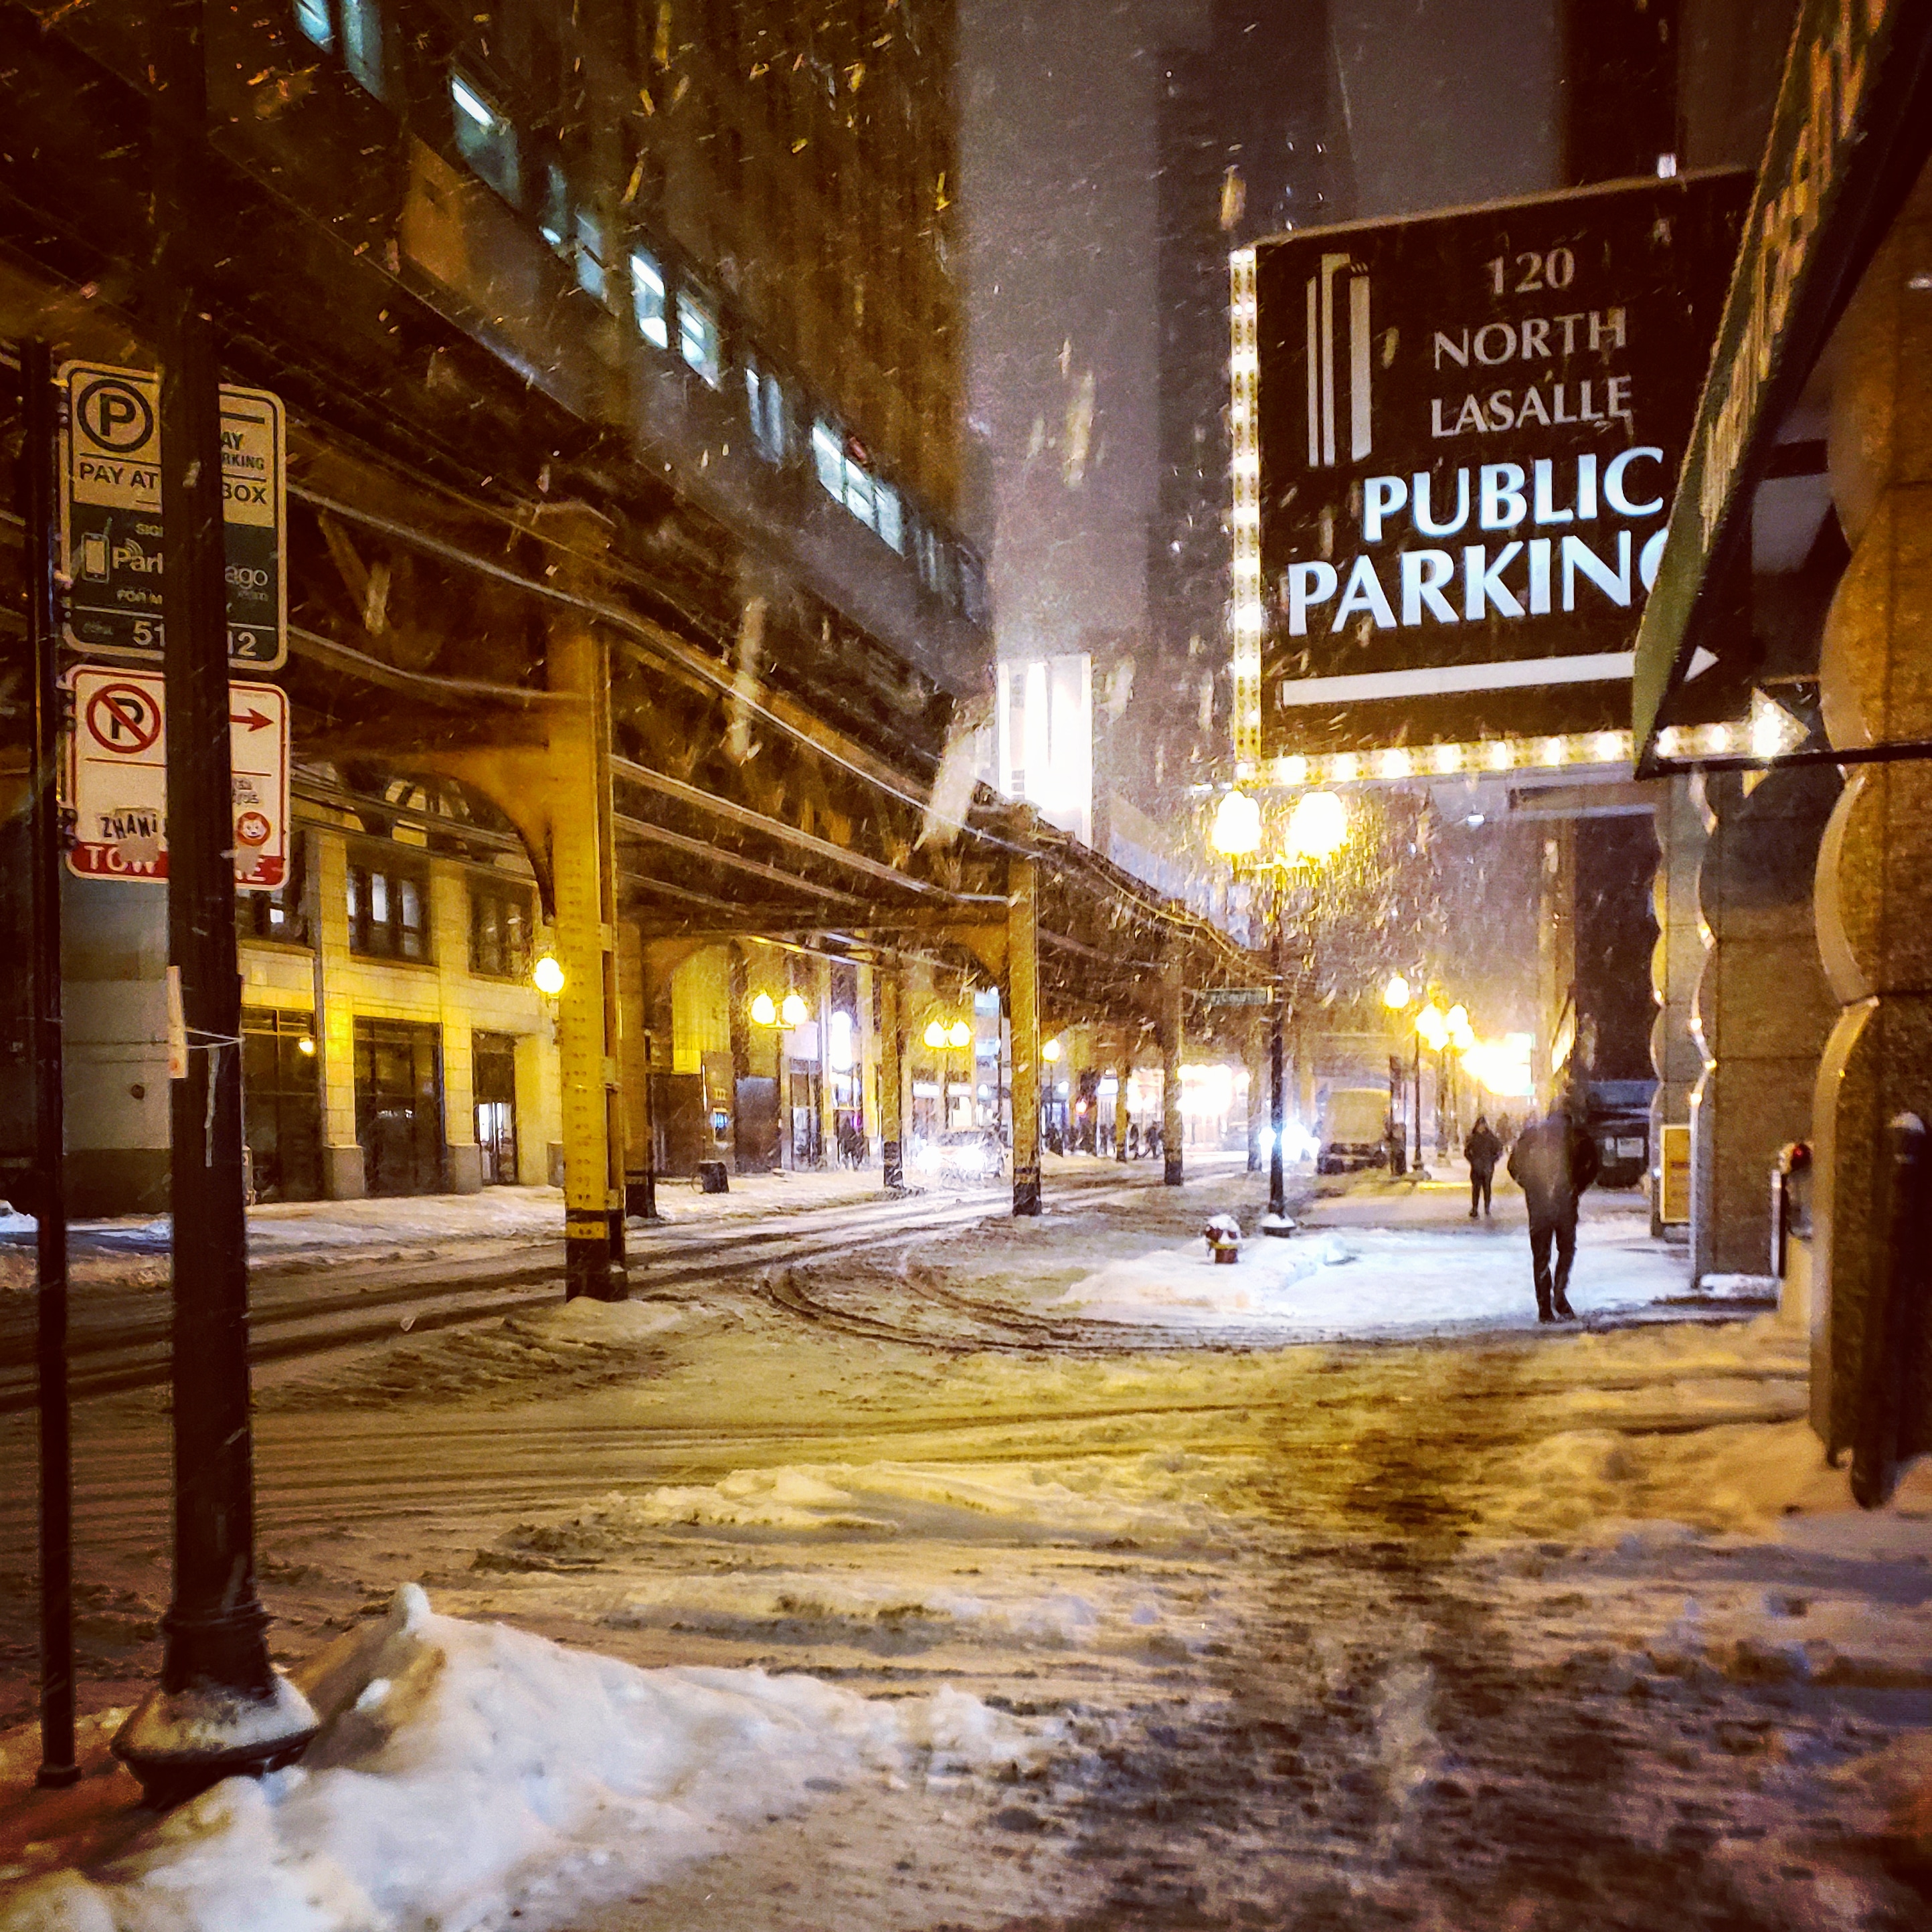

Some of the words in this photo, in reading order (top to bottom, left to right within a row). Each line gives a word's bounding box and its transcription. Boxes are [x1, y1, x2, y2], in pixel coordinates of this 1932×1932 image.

[1488, 246, 1575, 294] 120
[1433, 306, 1627, 371] NORTH
[100, 393, 137, 437] P
[1430, 374, 1634, 439] LASALLE
[220, 431, 244, 451] AY
[222, 452, 265, 470] RKING
[79, 462, 124, 485] PAY
[130, 470, 159, 490] AT
[1363, 446, 1664, 543] PUBLIC
